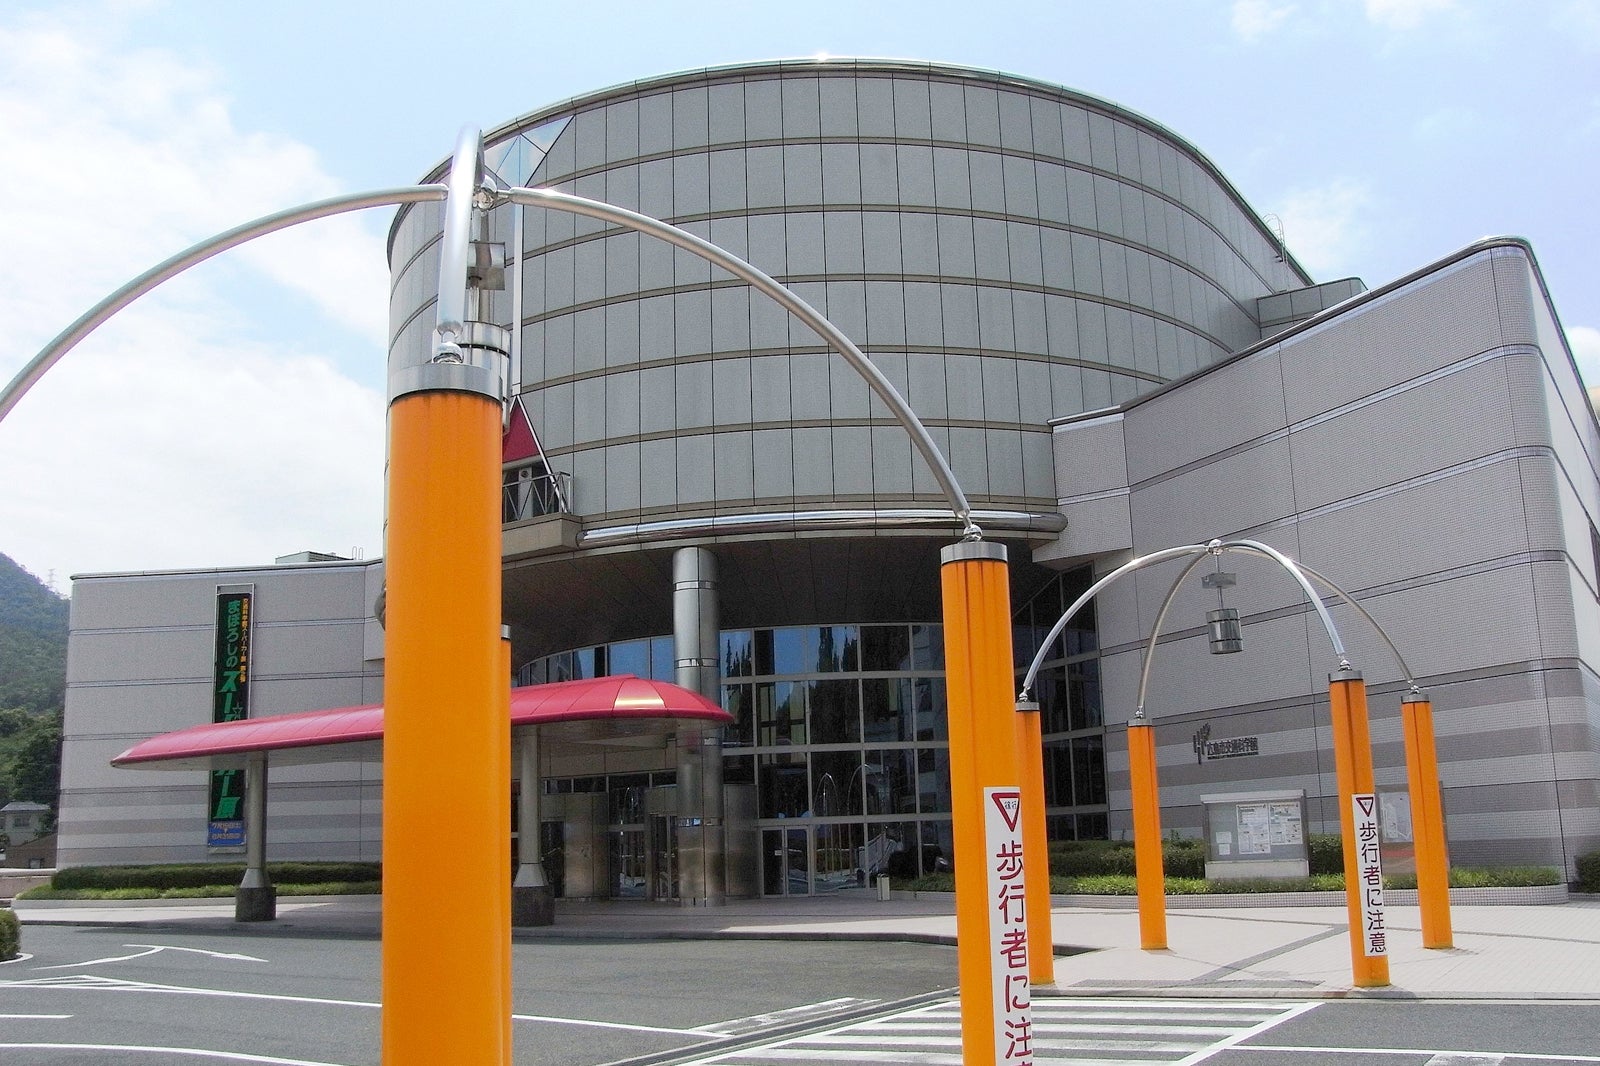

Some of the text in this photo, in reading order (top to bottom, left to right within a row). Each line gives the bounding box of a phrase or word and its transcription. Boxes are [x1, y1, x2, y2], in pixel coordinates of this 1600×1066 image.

[996, 840, 1033, 1066] 歩行者に注
[1359, 821, 1387, 954] 歩行者に注意
